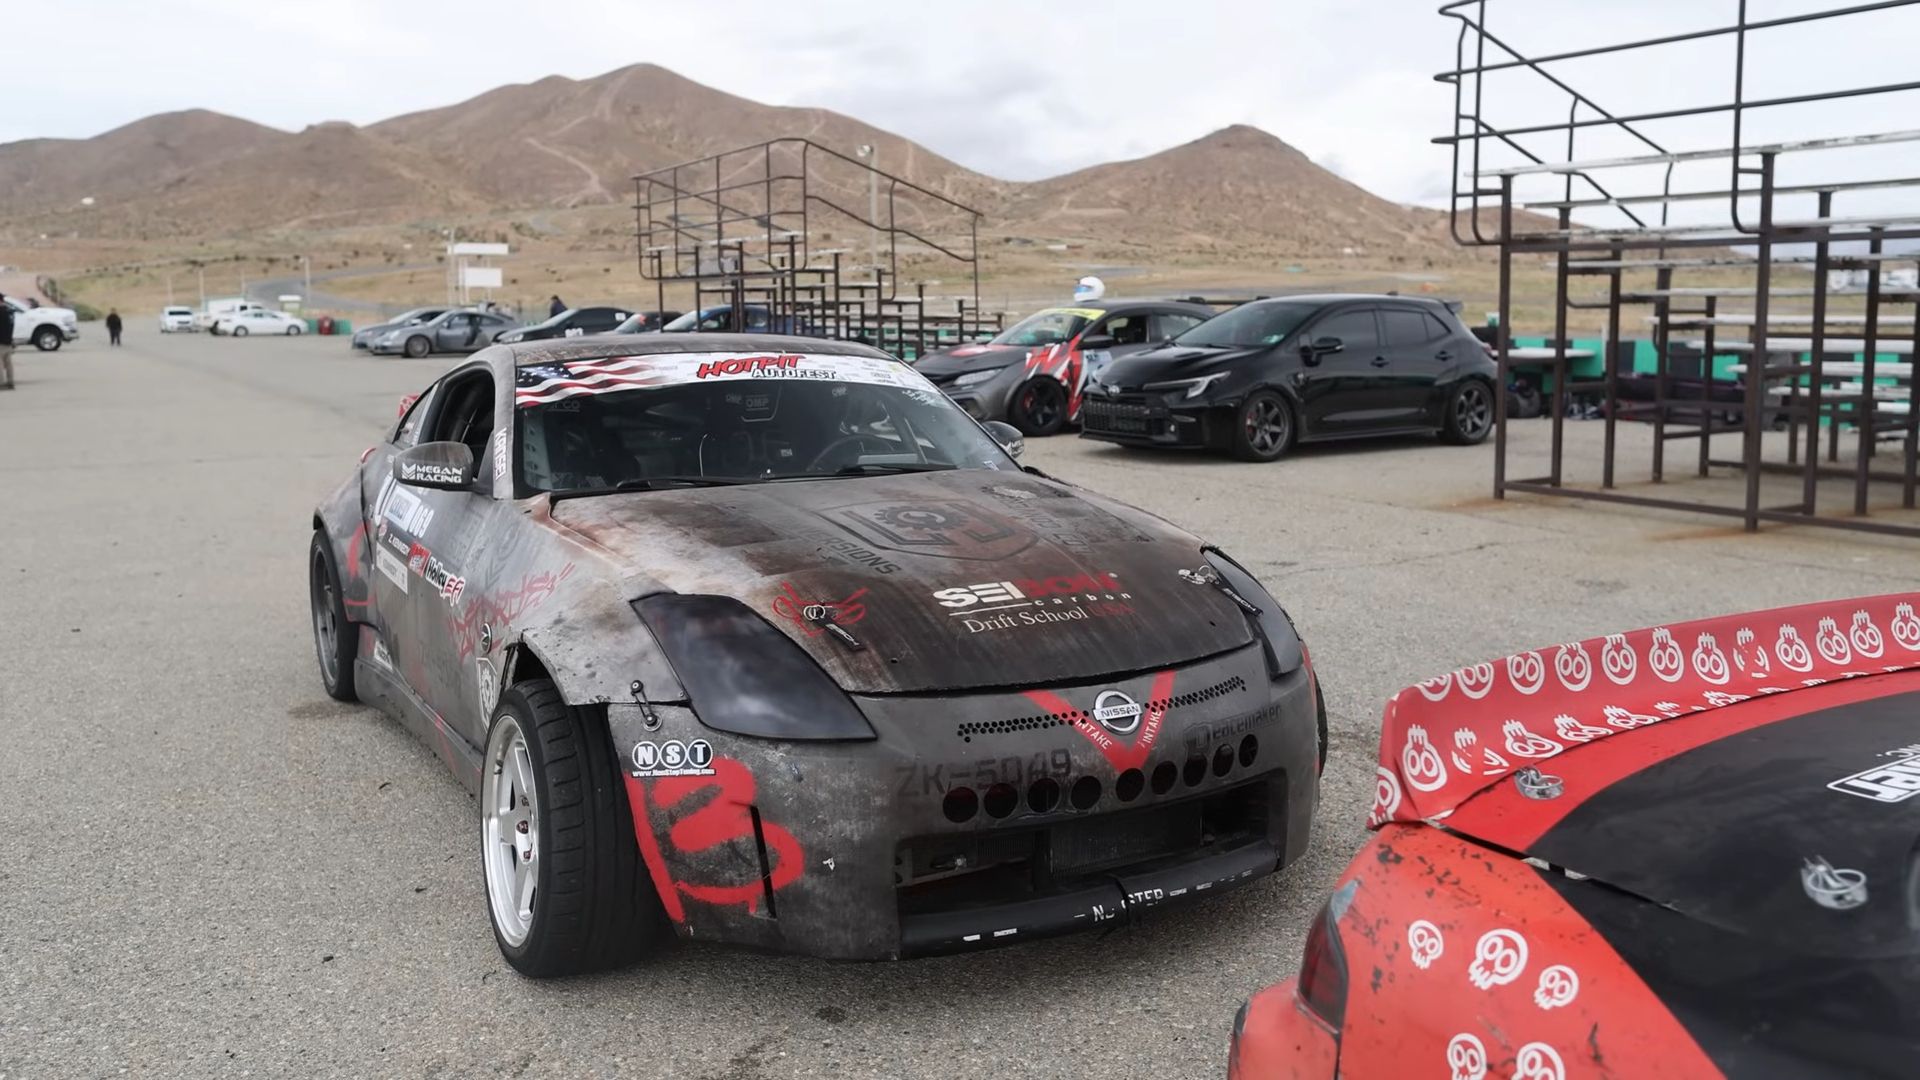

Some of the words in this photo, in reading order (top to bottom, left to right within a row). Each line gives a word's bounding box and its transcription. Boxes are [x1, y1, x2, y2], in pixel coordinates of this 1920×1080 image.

[697, 355, 806, 379] HOTPIT
[752, 368, 836, 379] AUTOFEST
[416, 465, 463, 475] MEGAN
[416, 473, 463, 483] RACING
[1034, 592, 1132, 607] carbon
[962, 613, 1018, 633] Drift
[1018, 606, 1089, 626] School
[1101, 705, 1139, 718] NISSAN
[1075, 718, 1113, 750] INTAKE
[1142, 711, 1162, 744] INTAKE
[634, 741, 712, 768] NST
